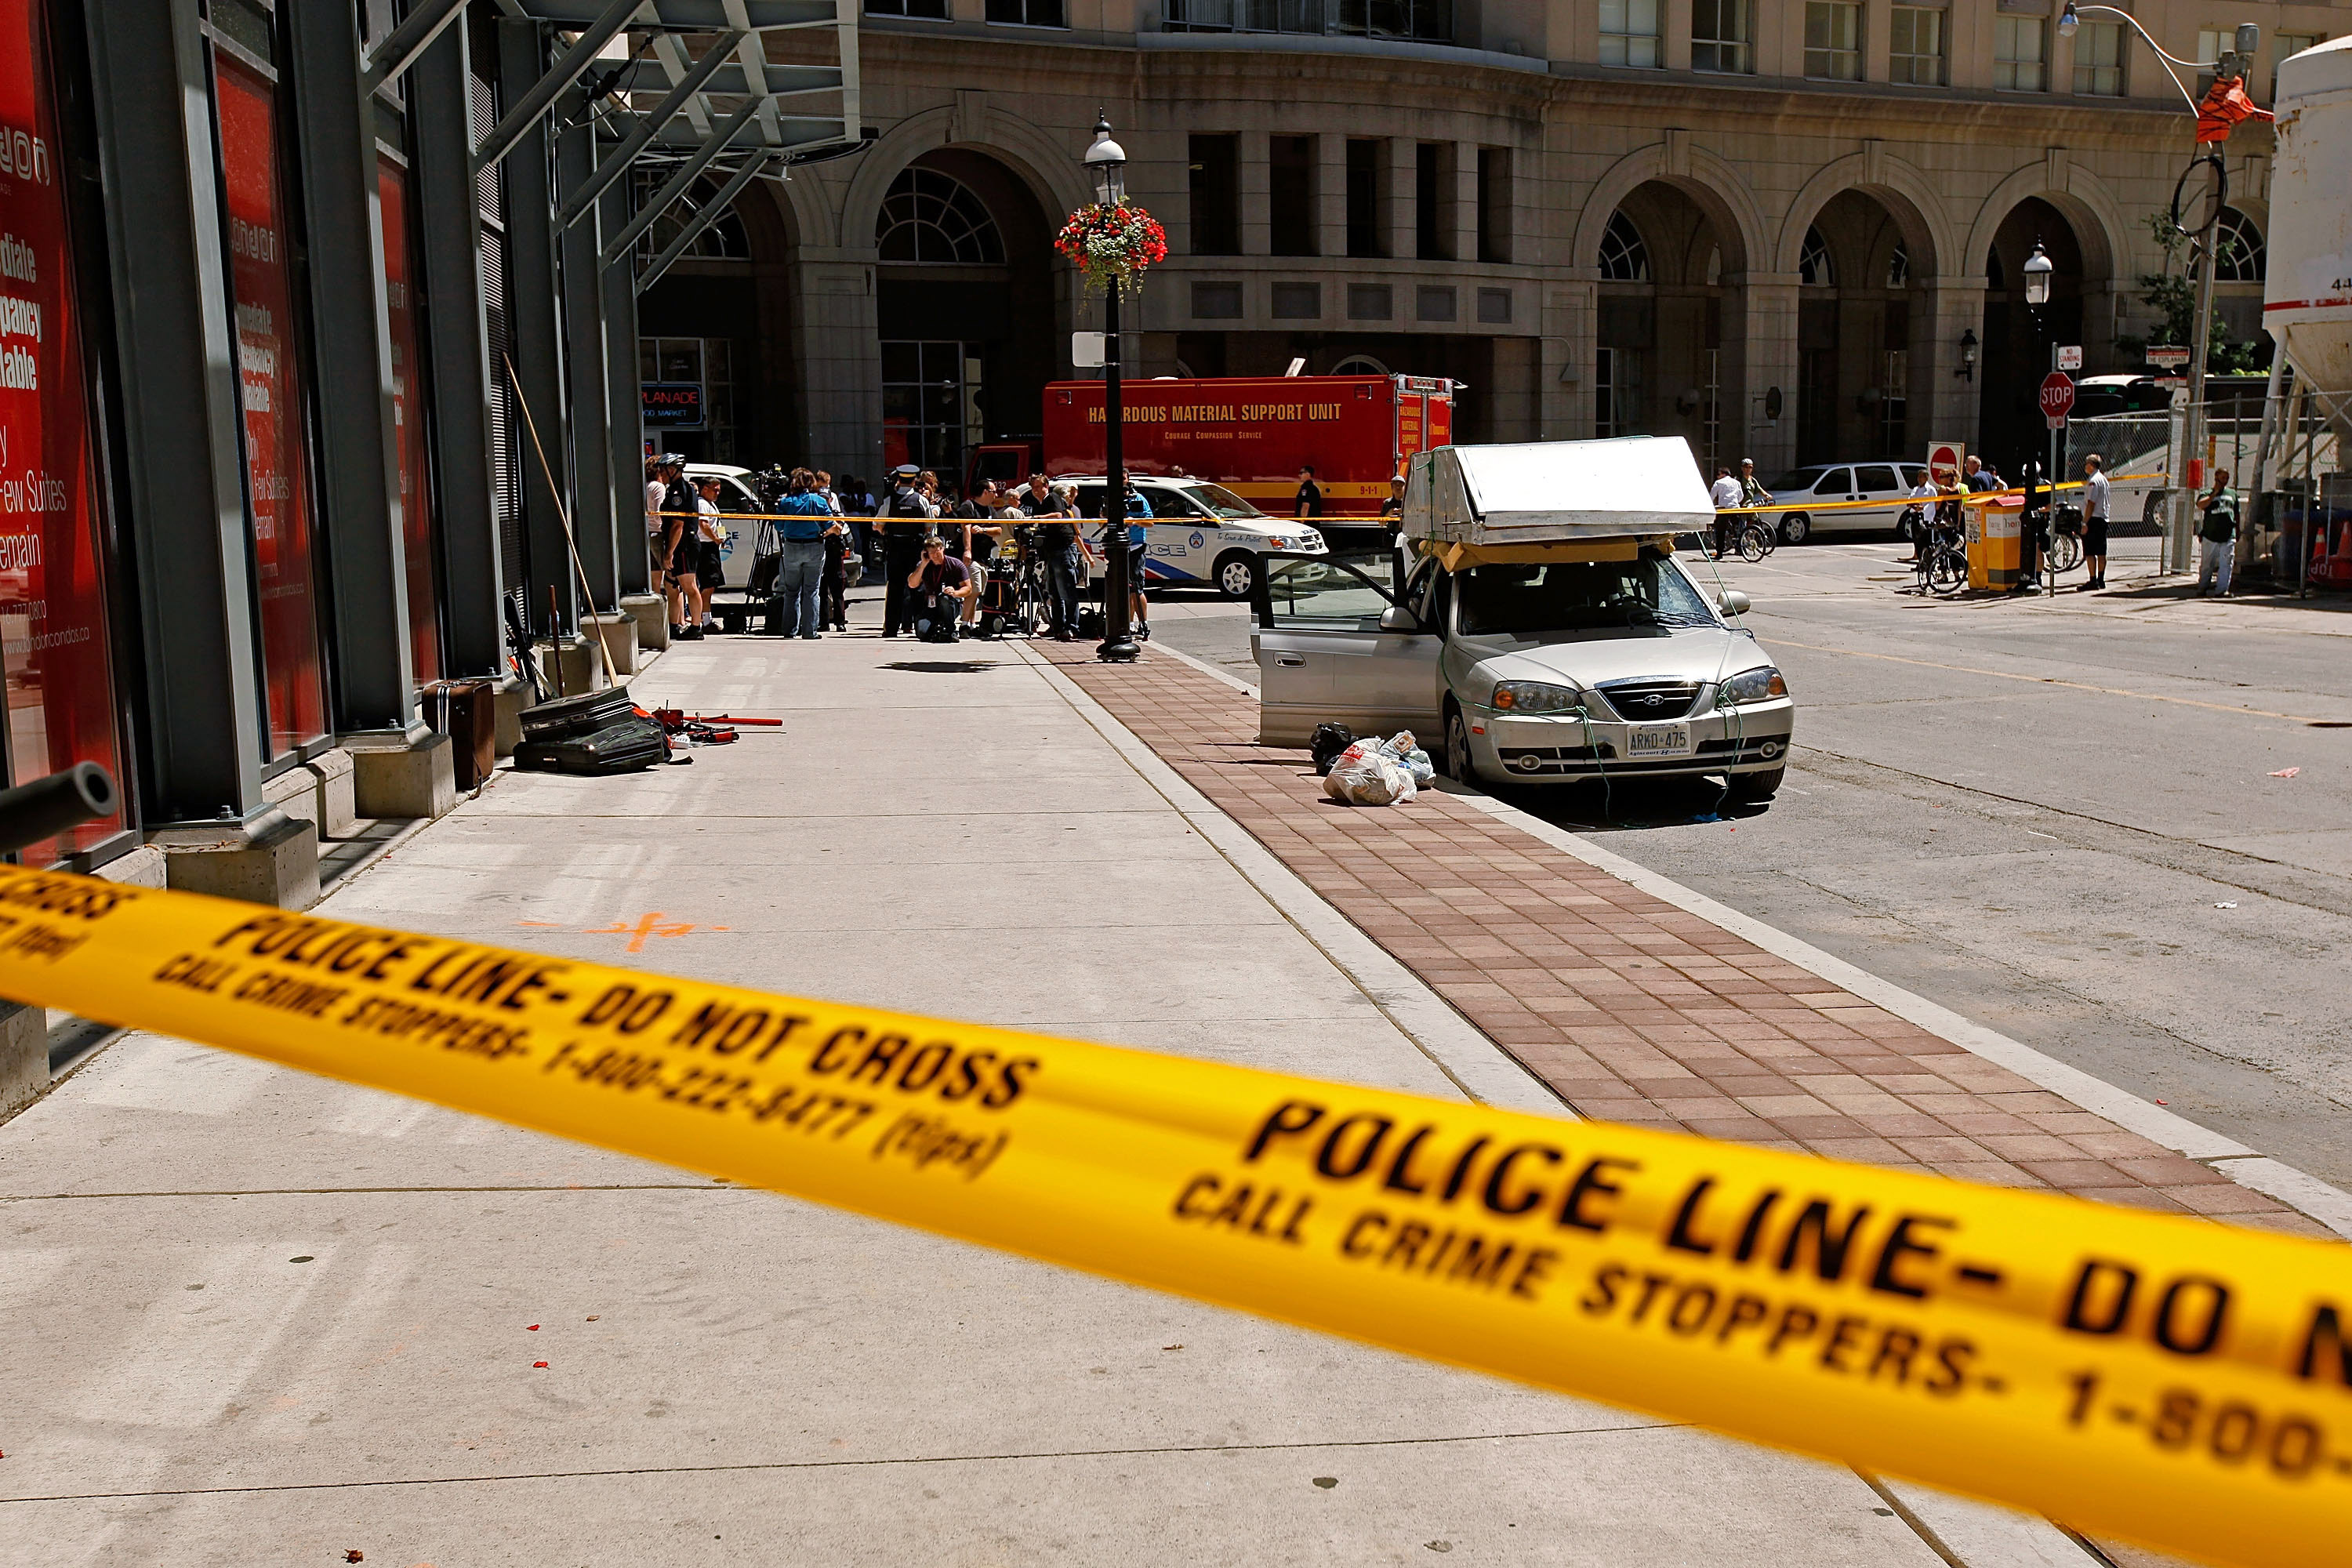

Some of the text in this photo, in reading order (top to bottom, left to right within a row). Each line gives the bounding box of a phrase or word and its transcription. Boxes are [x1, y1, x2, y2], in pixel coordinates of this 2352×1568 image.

[1088, 403, 1342, 423] HARDOUS MATERIAL SUPPORT UNIT
[2042, 387, 2071, 405] STOP
[27, 470, 67, 512] Suites
[1360, 485, 1377, 495] 9-1-1
[1665, 731, 1686, 747] 475
[153, 953, 239, 994] CALL
[232, 970, 349, 1019] CRIME
[213, 911, 431, 982] POLICE
[577, 982, 677, 1035] DO
[669, 1000, 813, 1064] NOT
[808, 1024, 1042, 1112] CROSS
[1171, 1171, 1315, 1248] CALL
[1340, 1209, 1564, 1303] CRIME
[1242, 1098, 1645, 1233] POLICE
[2060, 1258, 2233, 1357] DO
